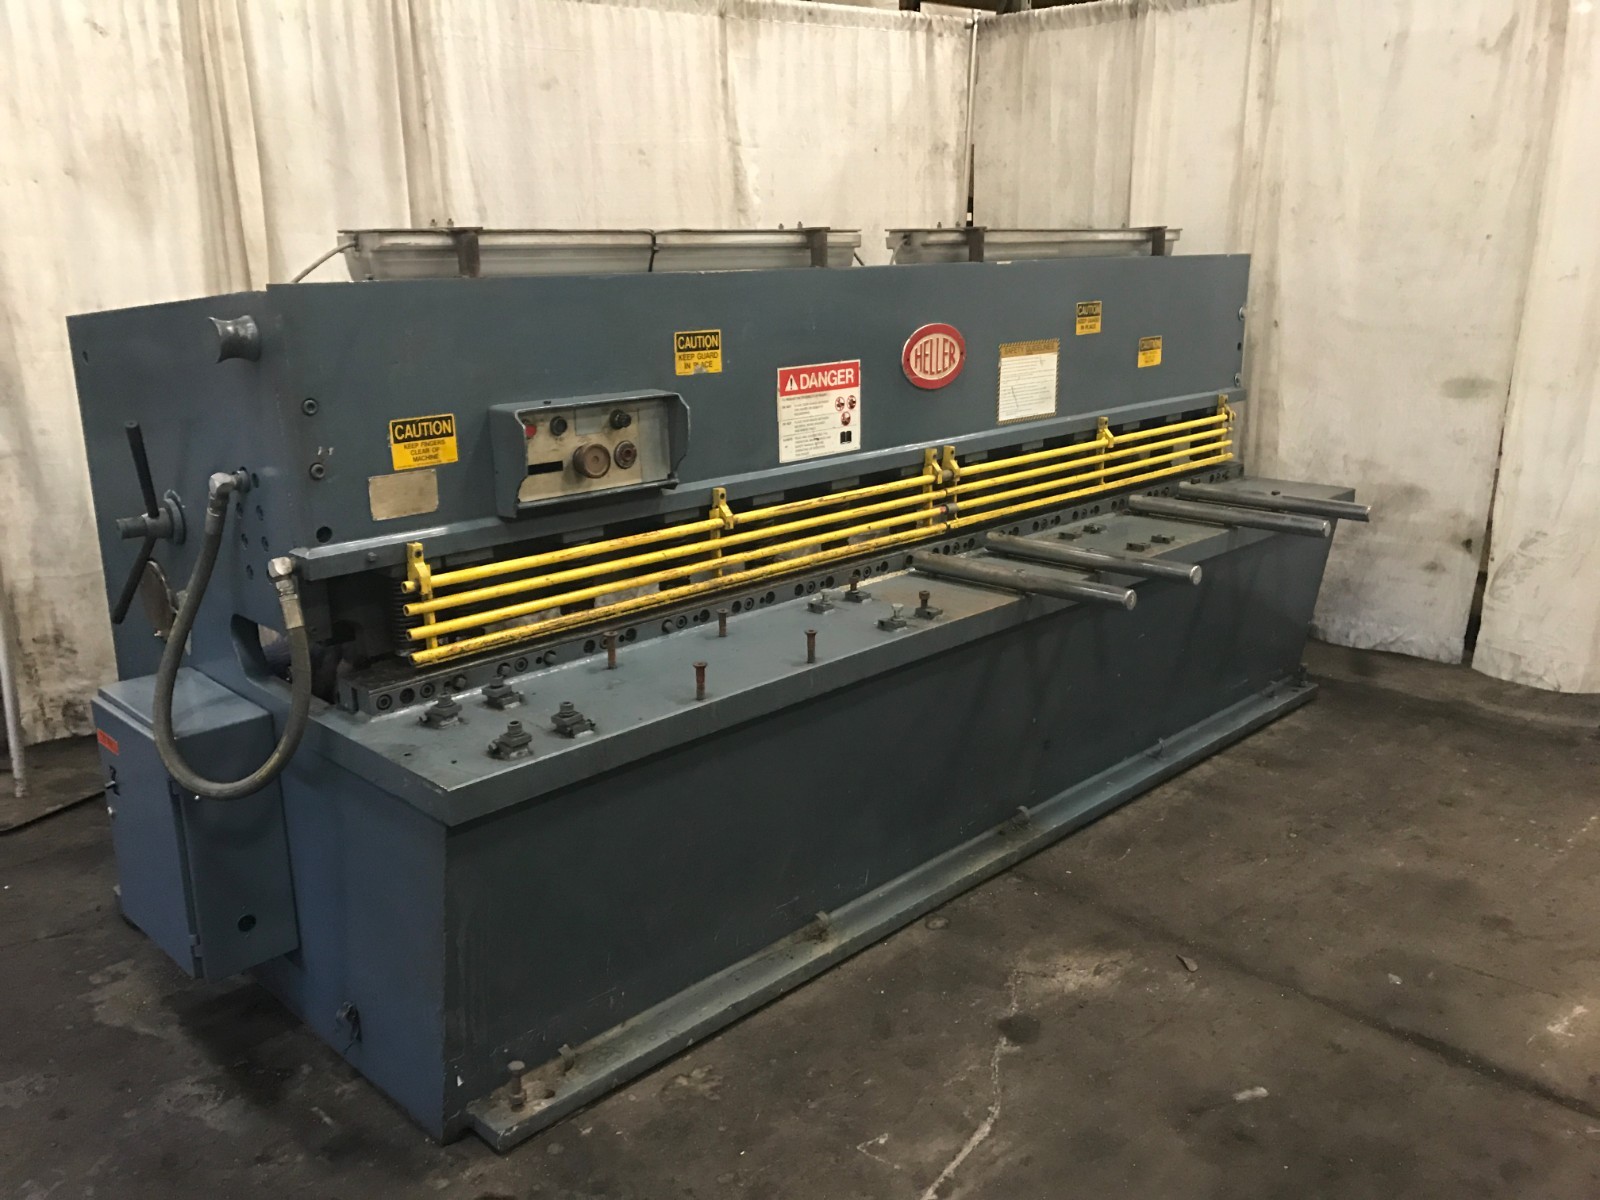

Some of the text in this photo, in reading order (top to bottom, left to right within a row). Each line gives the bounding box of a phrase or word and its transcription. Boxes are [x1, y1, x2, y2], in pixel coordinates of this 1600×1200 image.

[678, 334, 718, 350] CAUTION
[678, 351, 719, 361] KEEP GUARD
[914, 337, 956, 376] HELLER
[684, 362, 691, 370] IN
[800, 367, 855, 391] DANGER
[394, 420, 452, 440] CAUTION
[412, 454, 438, 462] MACHINE
